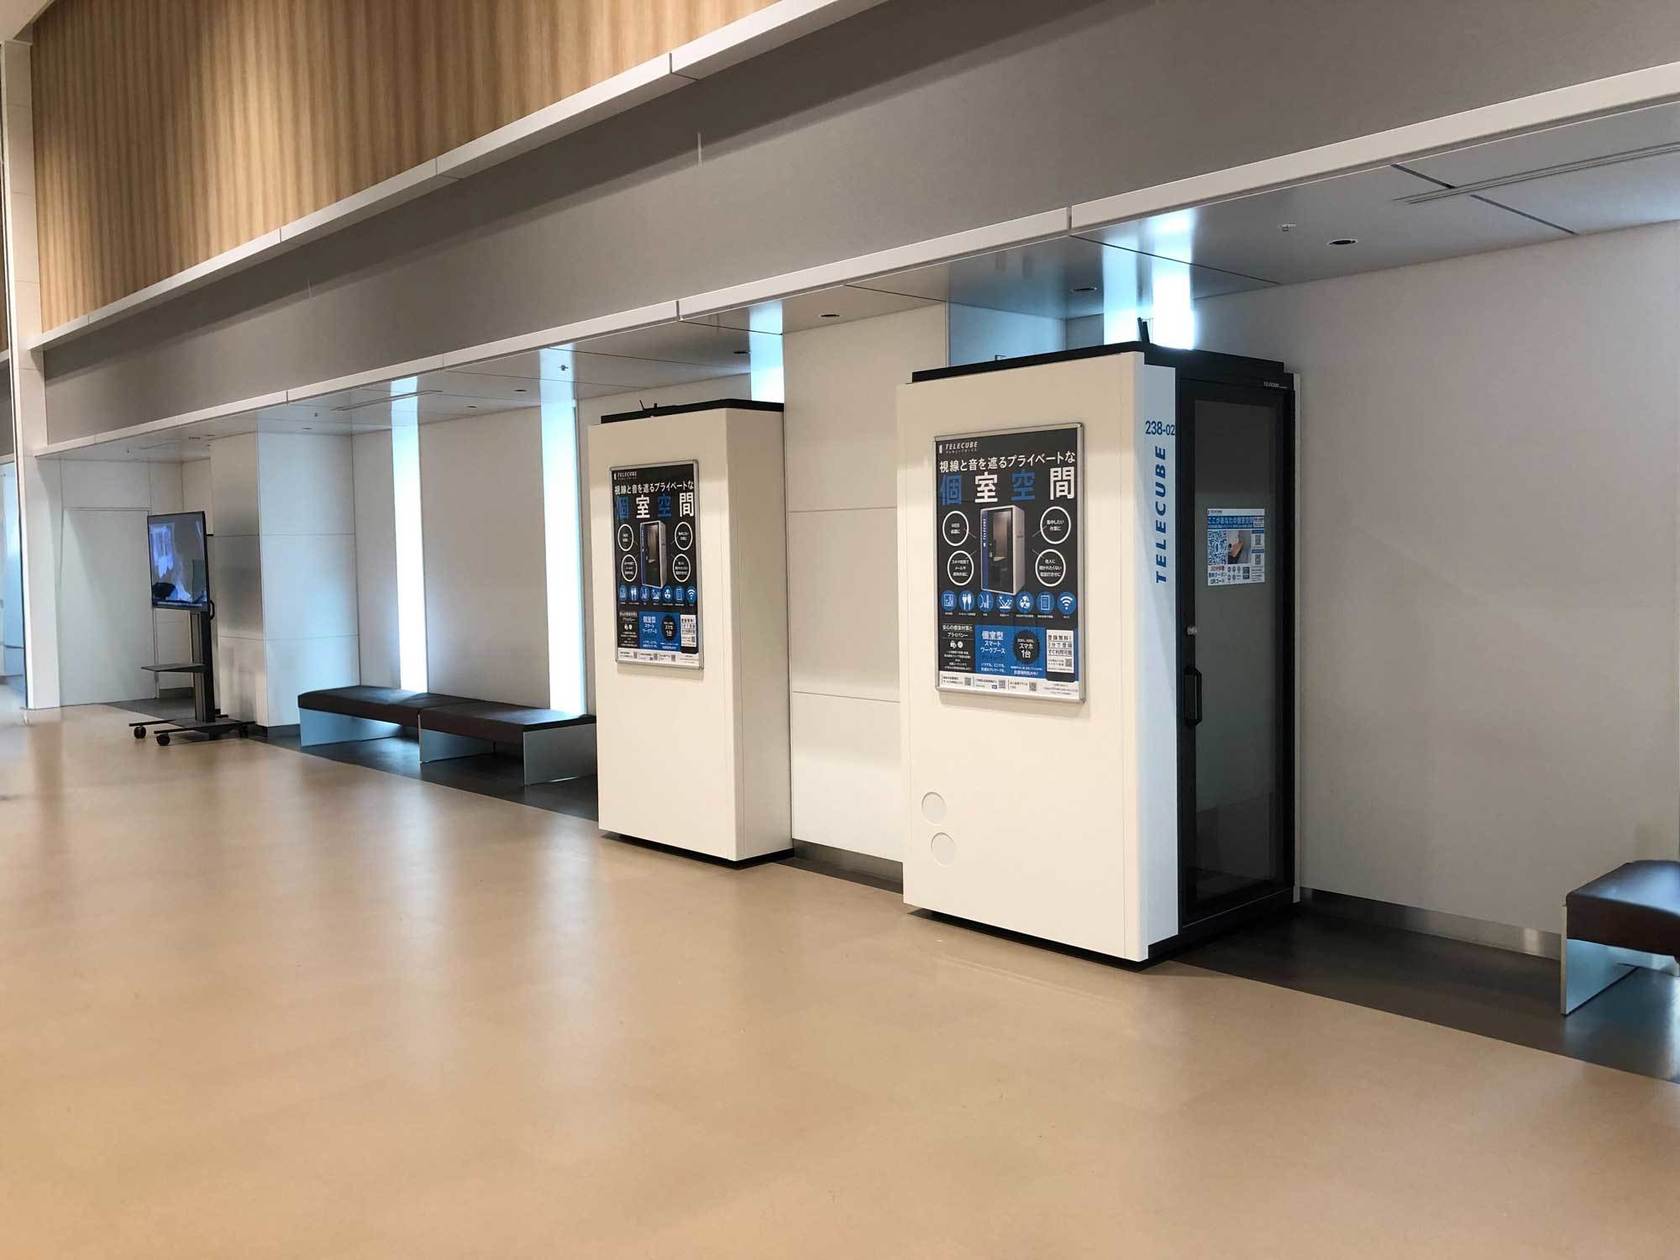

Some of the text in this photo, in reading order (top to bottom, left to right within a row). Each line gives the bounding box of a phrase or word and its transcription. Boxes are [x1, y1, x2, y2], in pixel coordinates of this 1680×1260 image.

[1145, 420, 1176, 436] 238-02
[945, 441, 978, 450] TELECUBE
[939, 450, 1076, 473] 視線と音を遮るプライベートな
[1155, 446, 1167, 584] TELECUBE
[1018, 642, 1033, 650] スマホ
[1021, 650, 1031, 659] 1台
